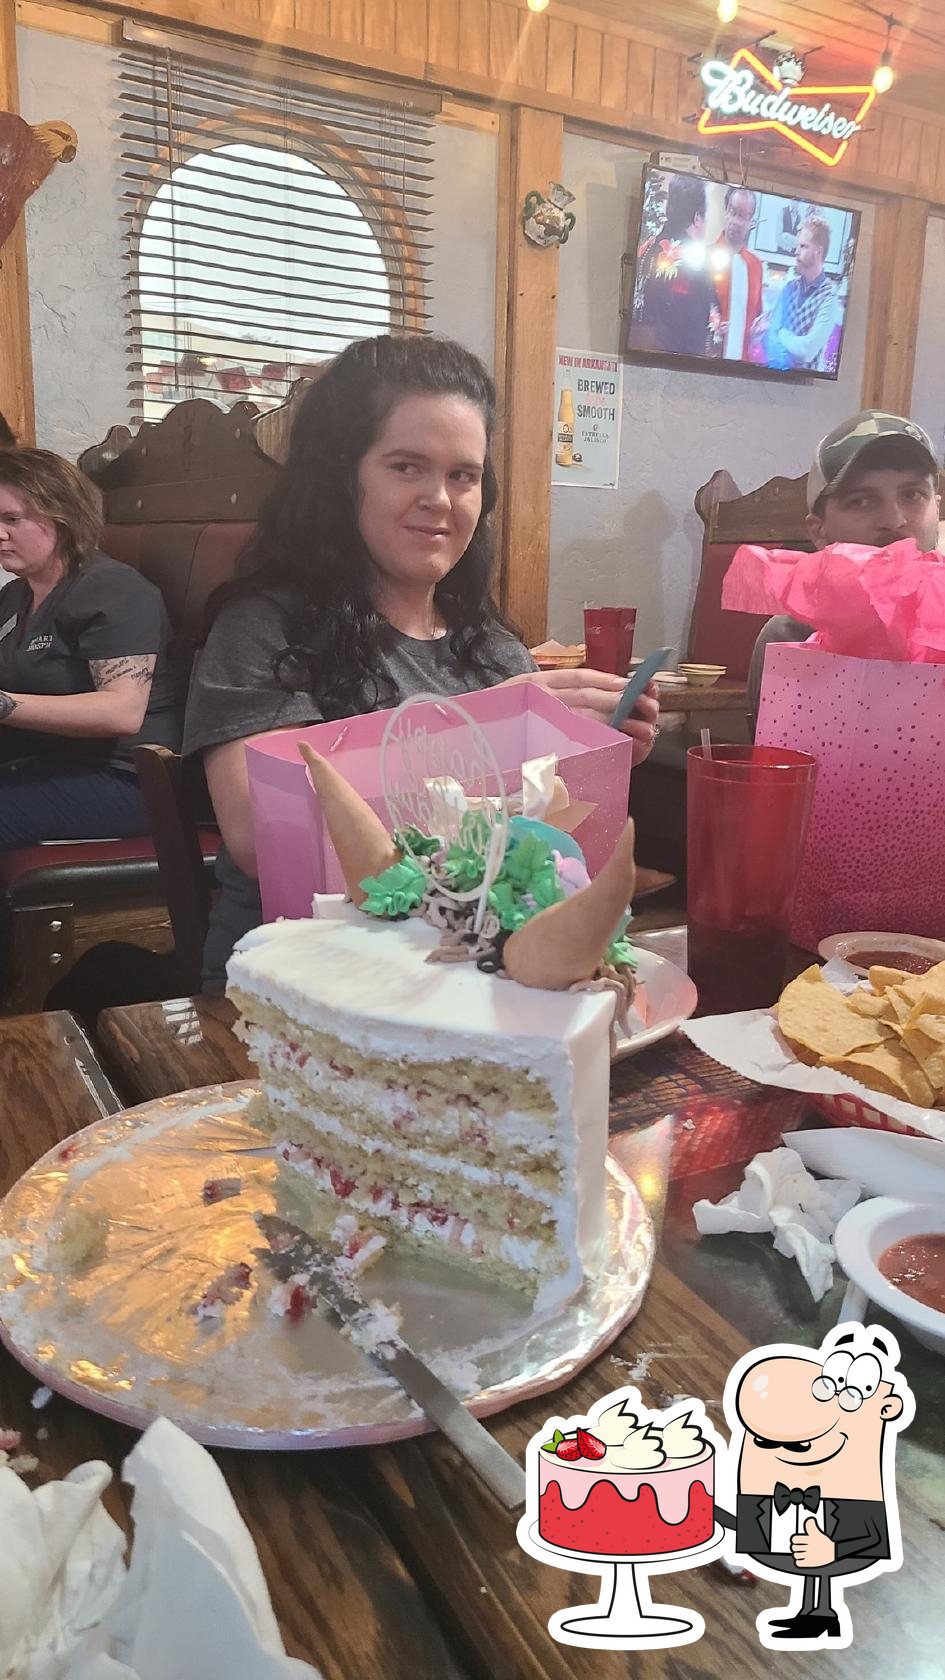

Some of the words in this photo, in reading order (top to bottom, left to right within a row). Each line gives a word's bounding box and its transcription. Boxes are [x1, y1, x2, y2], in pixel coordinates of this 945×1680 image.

[701, 61, 861, 140] Budweiser
[559, 355, 573, 367] NEW
[574, 357, 582, 368] IN
[577, 378, 616, 395] BREWED
[577, 404, 615, 421] SMOOTH
